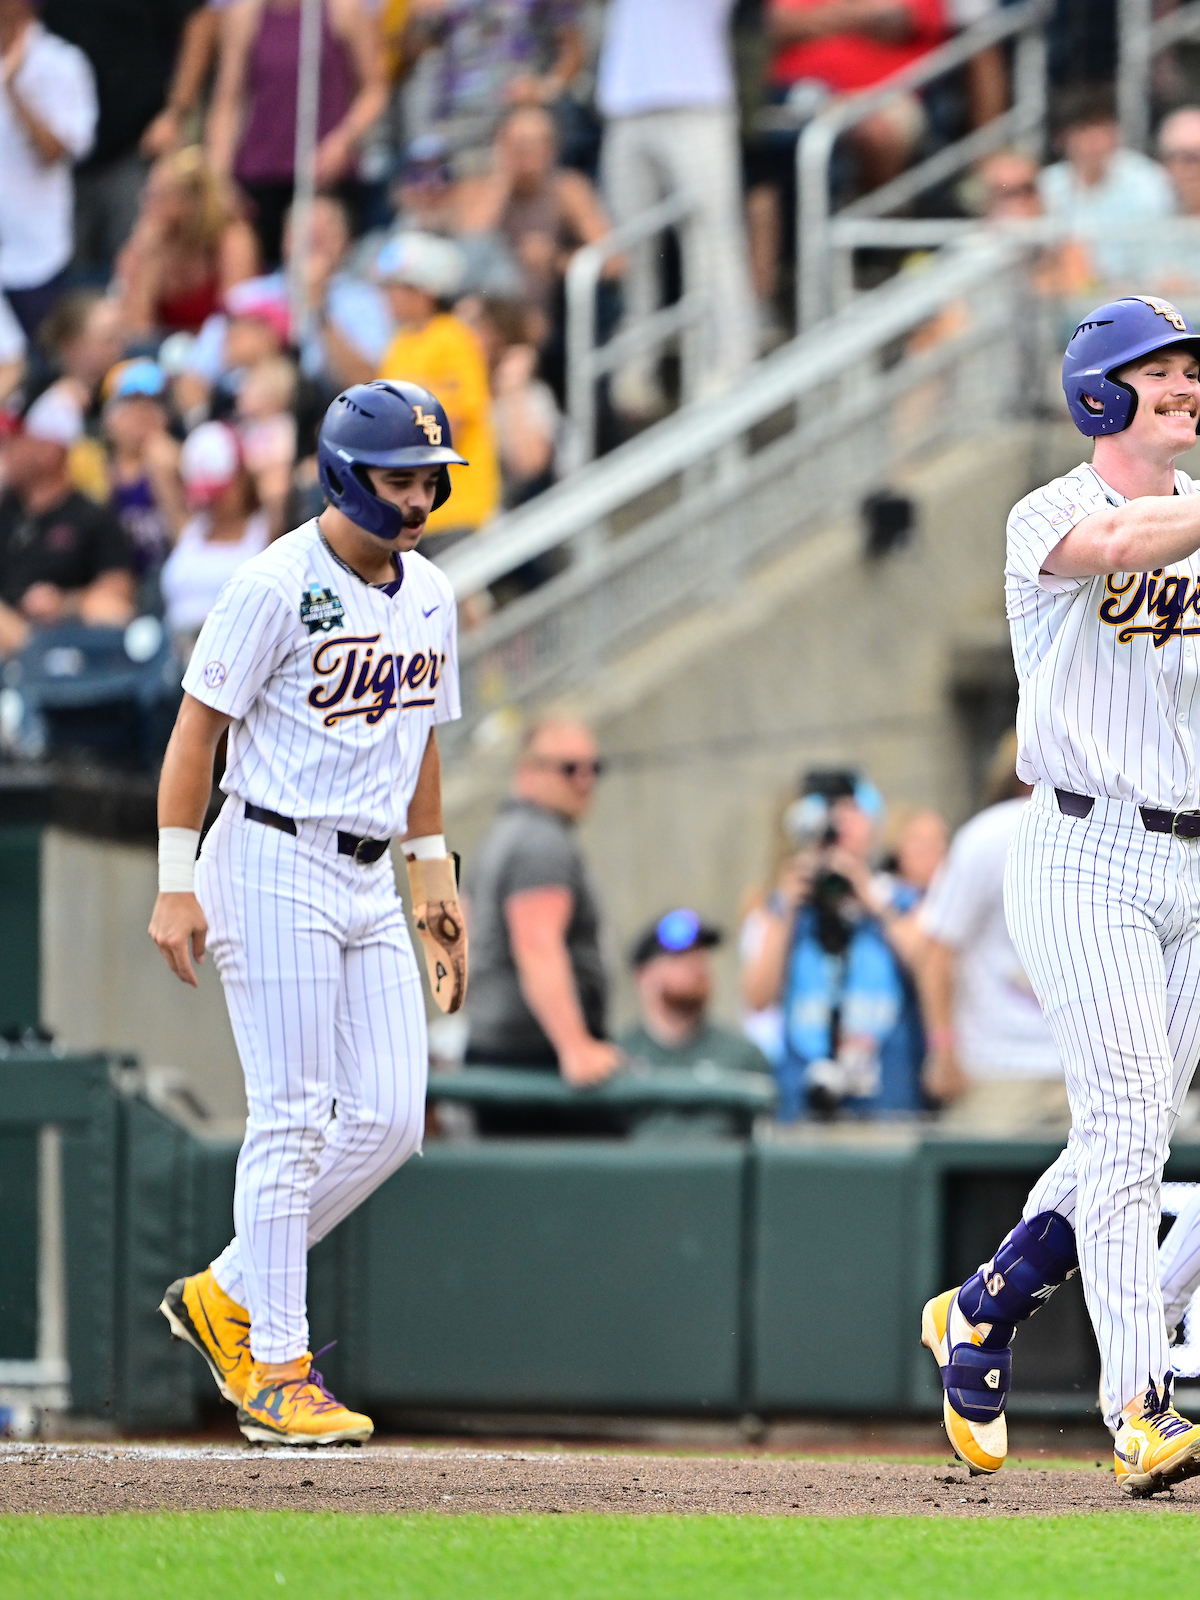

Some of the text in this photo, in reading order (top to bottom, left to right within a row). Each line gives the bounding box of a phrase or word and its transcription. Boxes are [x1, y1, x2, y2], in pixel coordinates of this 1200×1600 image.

[1146, 300, 1186, 331] LSU
[412, 405, 442, 445] LSU
[308, 633, 446, 727] Tiger
